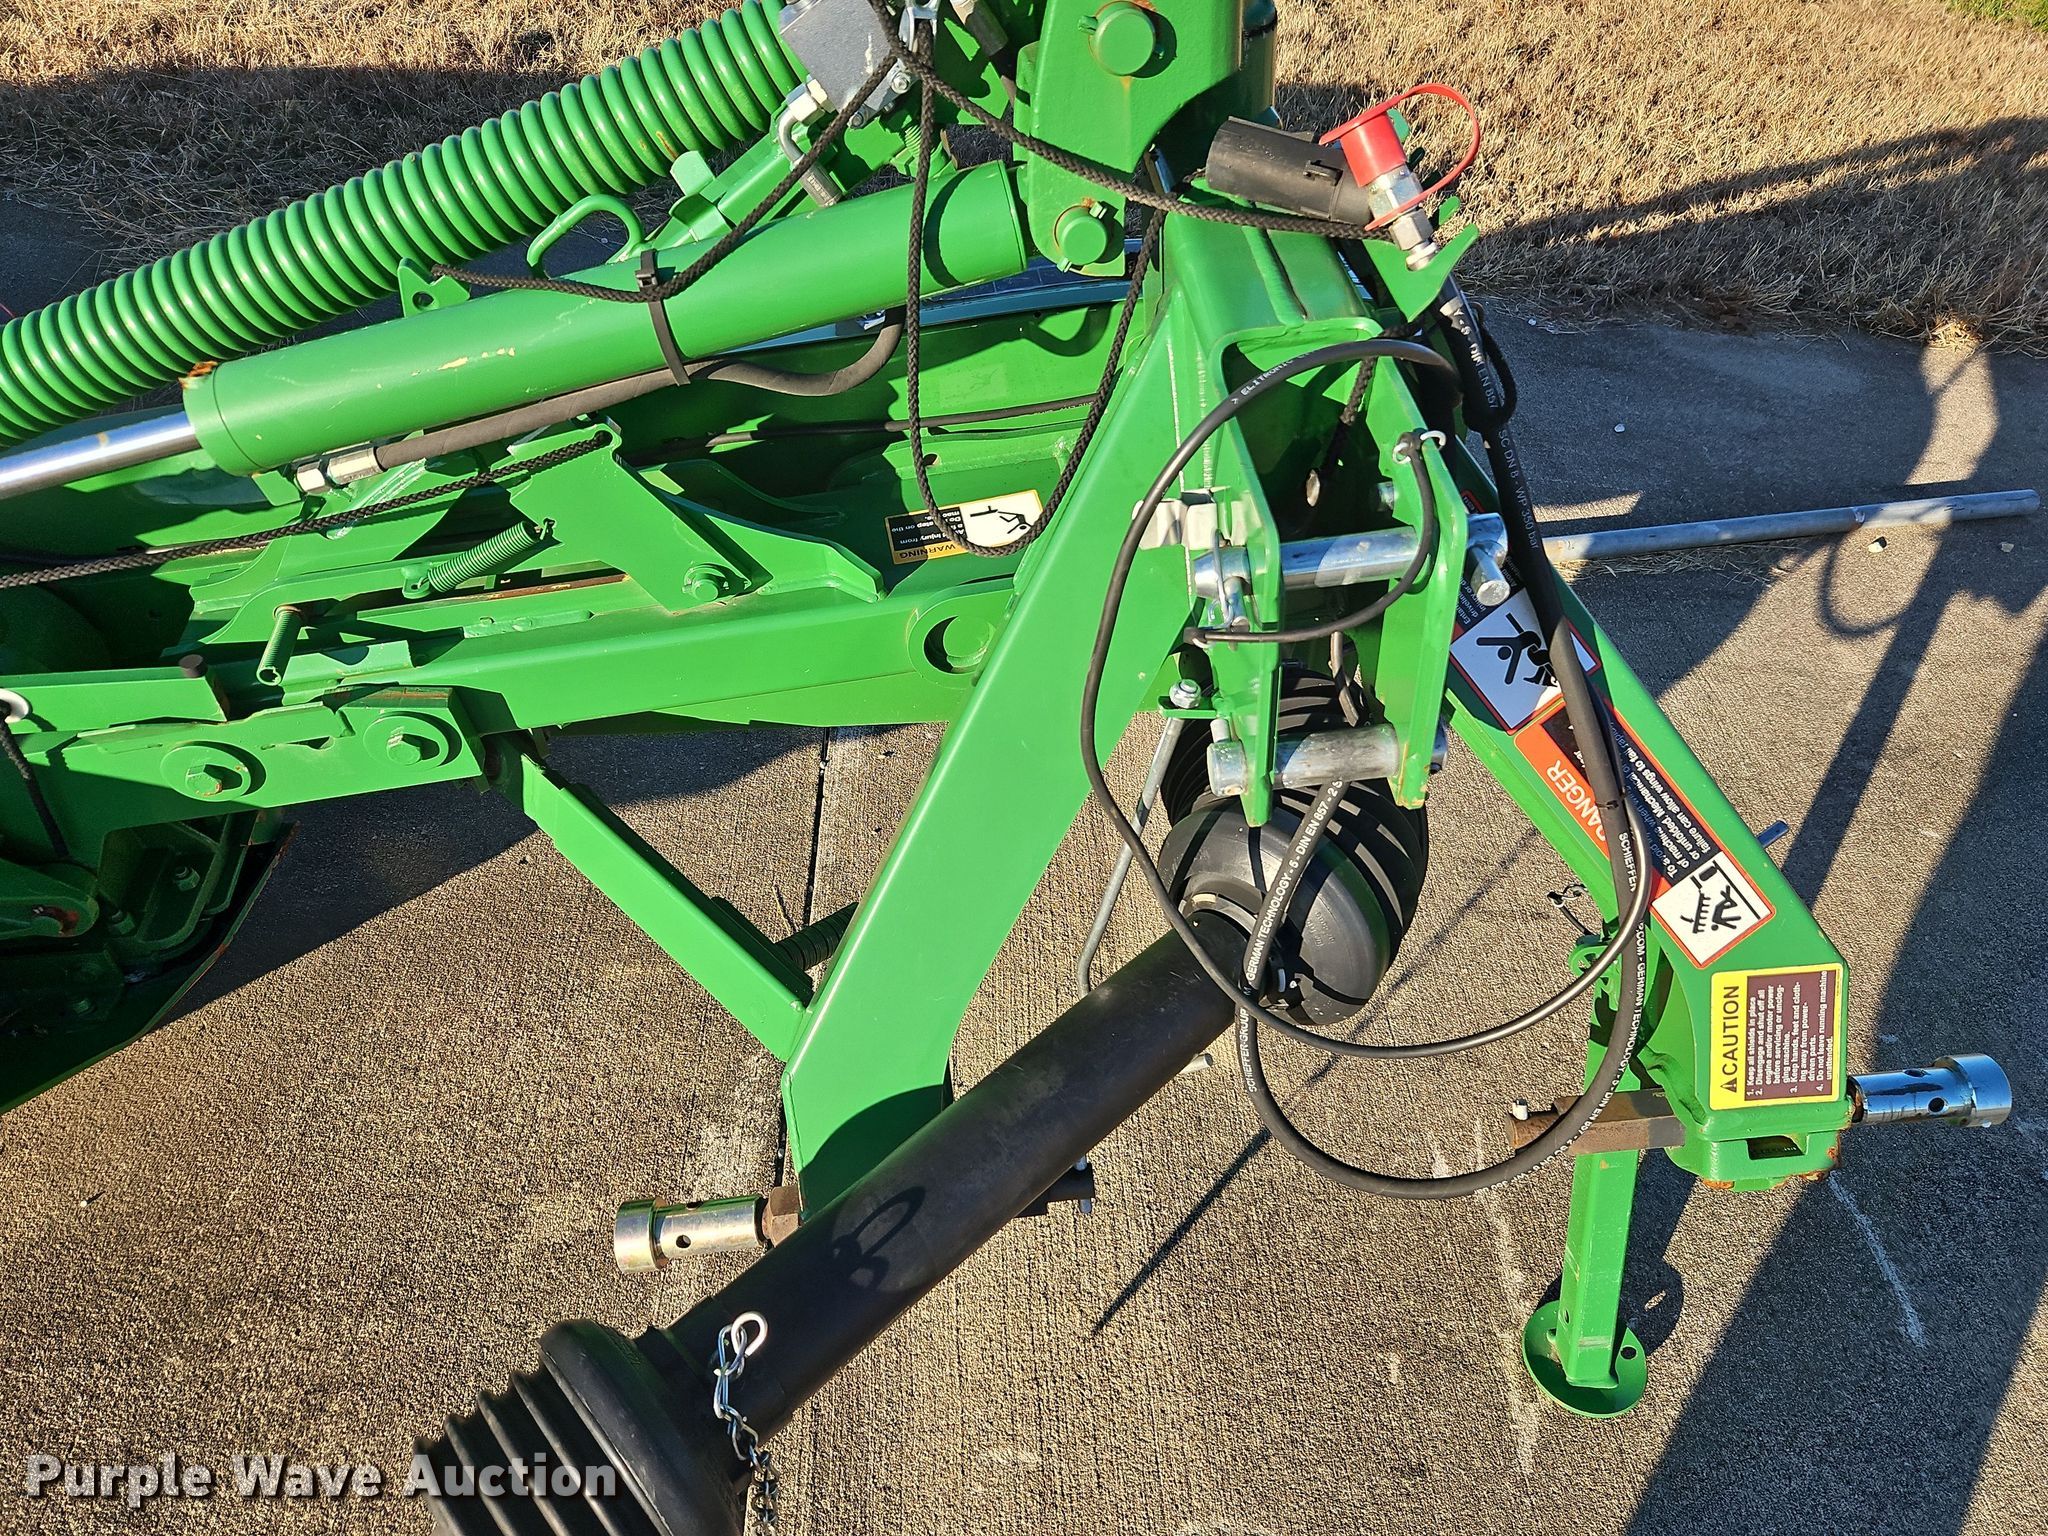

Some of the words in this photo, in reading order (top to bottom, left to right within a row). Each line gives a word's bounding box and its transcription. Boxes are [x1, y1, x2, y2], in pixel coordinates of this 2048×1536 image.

[1503, 449, 1517, 469] DN
[1514, 487, 1528, 507] WP
[1526, 530, 1540, 549] bar
[899, 543, 956, 559] WARNING
[1633, 759, 1646, 772] to
[1642, 767, 1665, 794] wings
[1627, 772, 1665, 817] Mechanical
[1659, 791, 1680, 815] allow
[1636, 805, 1655, 827] when
[1676, 811, 1692, 830] can
[1653, 826, 1682, 860] machine
[1661, 815, 1692, 852] unfolded.
[1688, 827, 1711, 853] failure
[1677, 857, 1690, 870] of
[1689, 849, 1701, 861] or
[1665, 863, 1679, 878] To
[1246, 939, 1265, 981] GERMAN
[1259, 873, 1292, 940] TECHNOLOGY
[1295, 835, 1312, 856] DIN
[1305, 819, 1320, 837] EN
[1313, 800, 1330, 821] 857
[1635, 963, 1645, 1006] GERMAN
[1749, 997, 1757, 1017] place
[1776, 985, 1784, 1013] unclog-
[1722, 986, 1739, 1075] CAUTION
[1776, 1015, 1781, 1023] or
[1818, 1004, 1827, 1033] running
[1618, 1006, 1643, 1073] TECHNOLOGY
[1774, 1025, 1783, 1058] servicing
[1747, 1067, 1756, 1085] Keep
[1756, 1046, 1764, 1085] Disengage
[1791, 1064, 1799, 1082] Keep
[1817, 1070, 1824, 1080] Do
